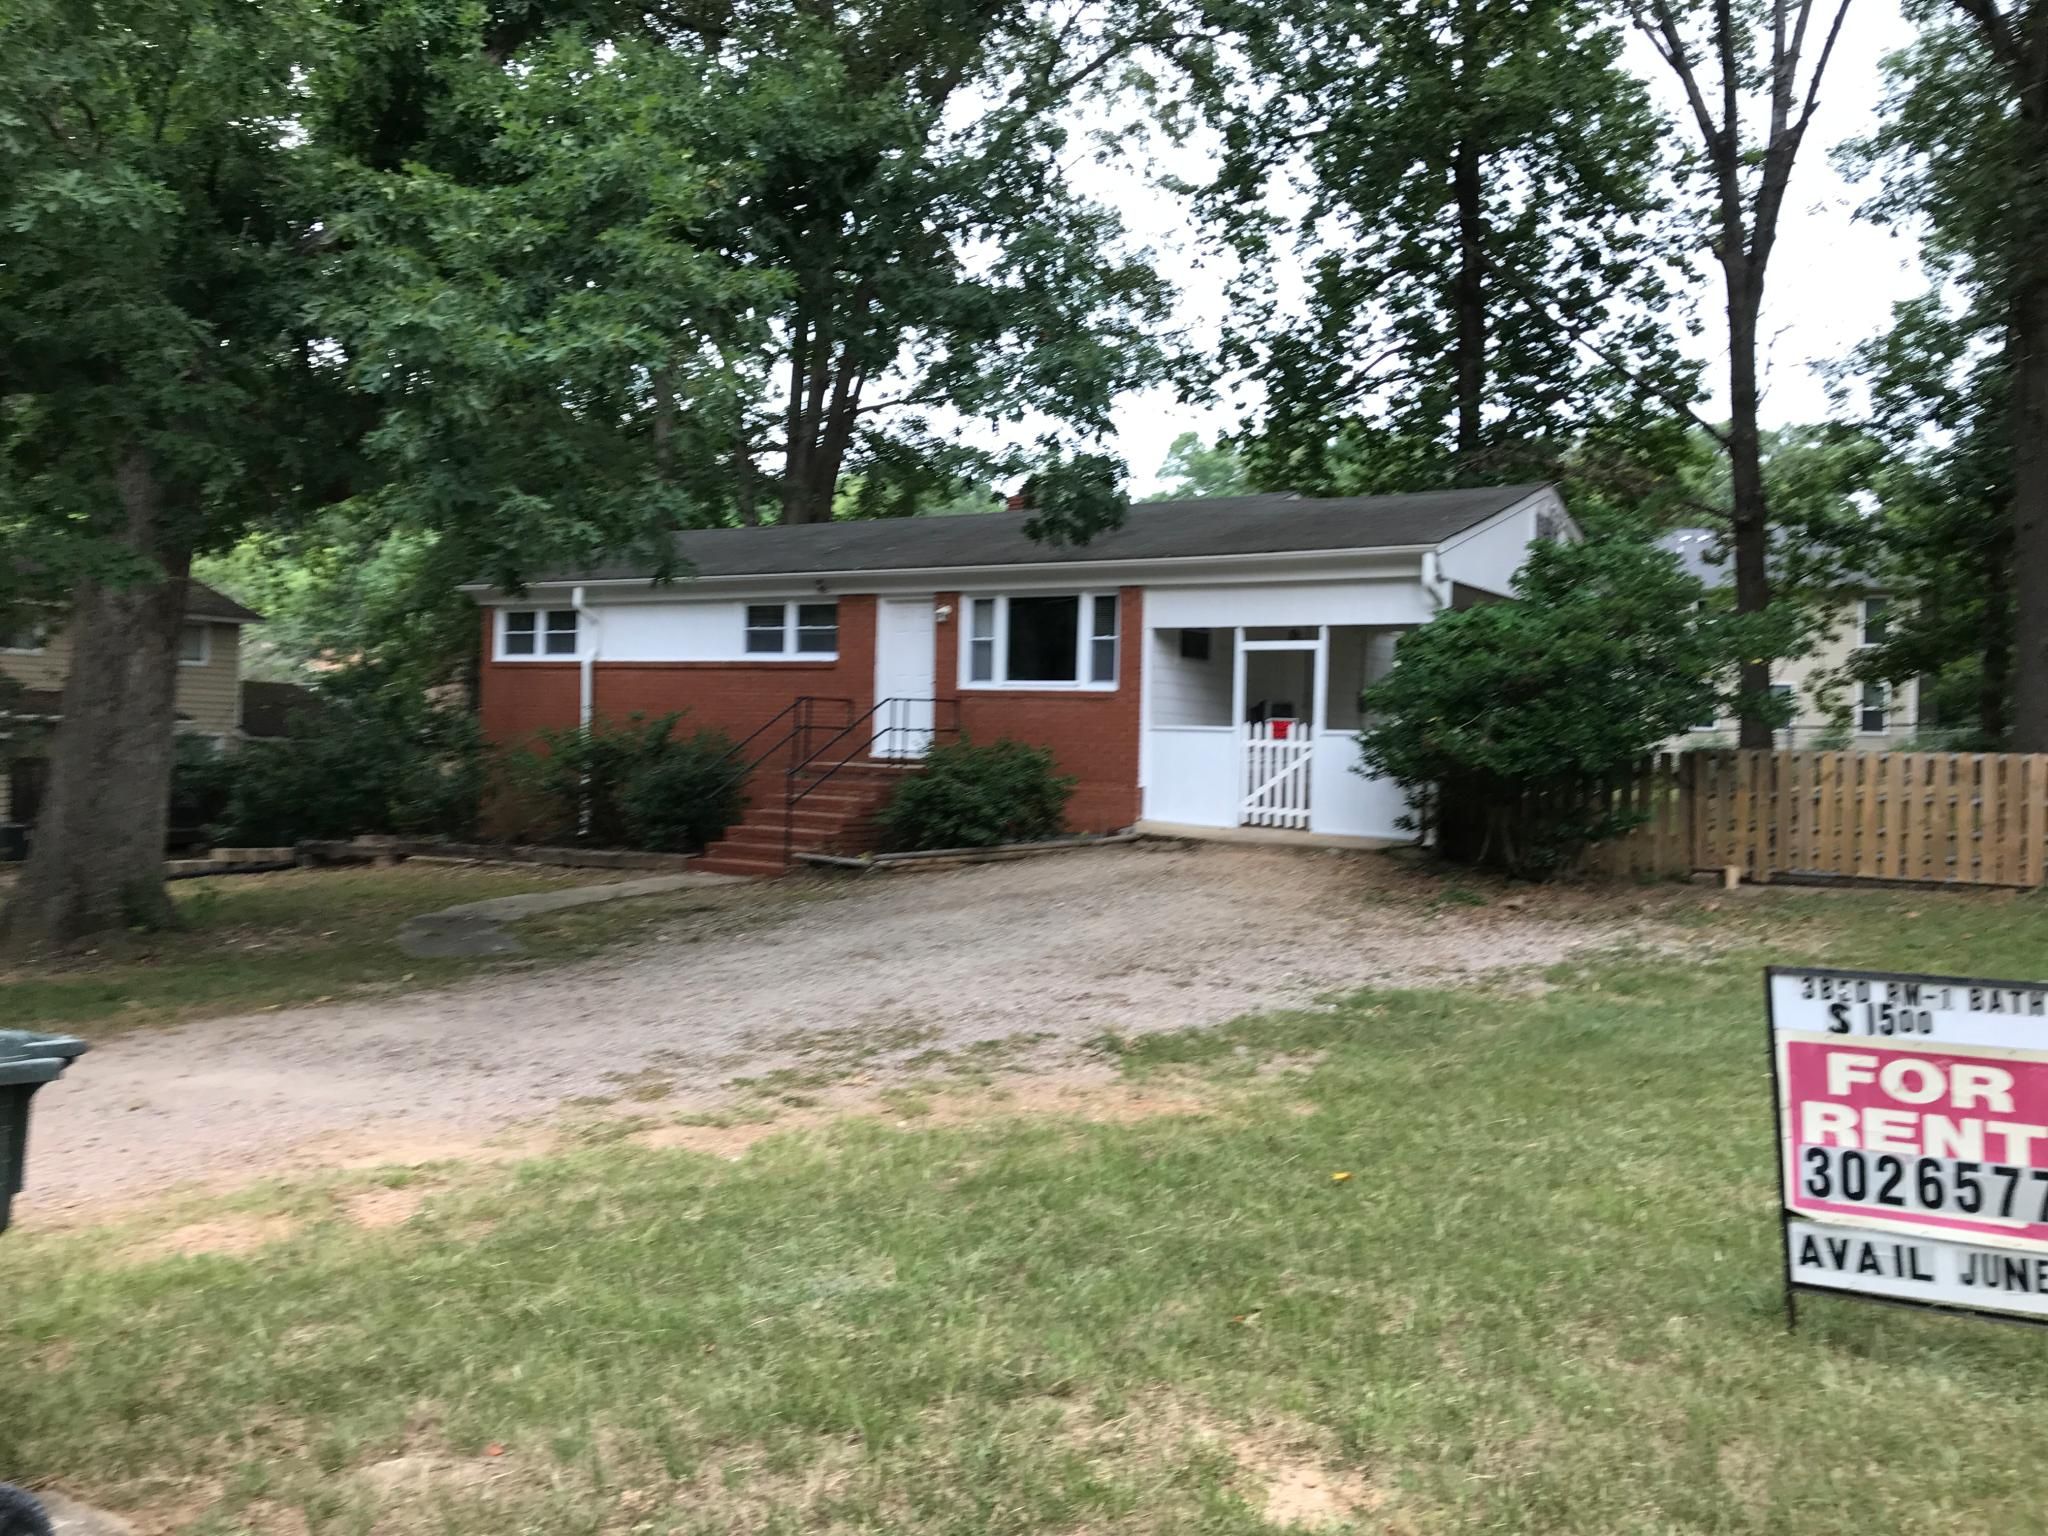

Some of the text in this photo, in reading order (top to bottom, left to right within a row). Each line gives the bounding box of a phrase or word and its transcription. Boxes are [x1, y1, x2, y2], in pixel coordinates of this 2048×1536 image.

[1826, 1051, 2016, 1113] FOR
[1800, 1100, 2048, 1168] RENT
[1801, 1234, 2048, 1294] AVAIL JUNE
